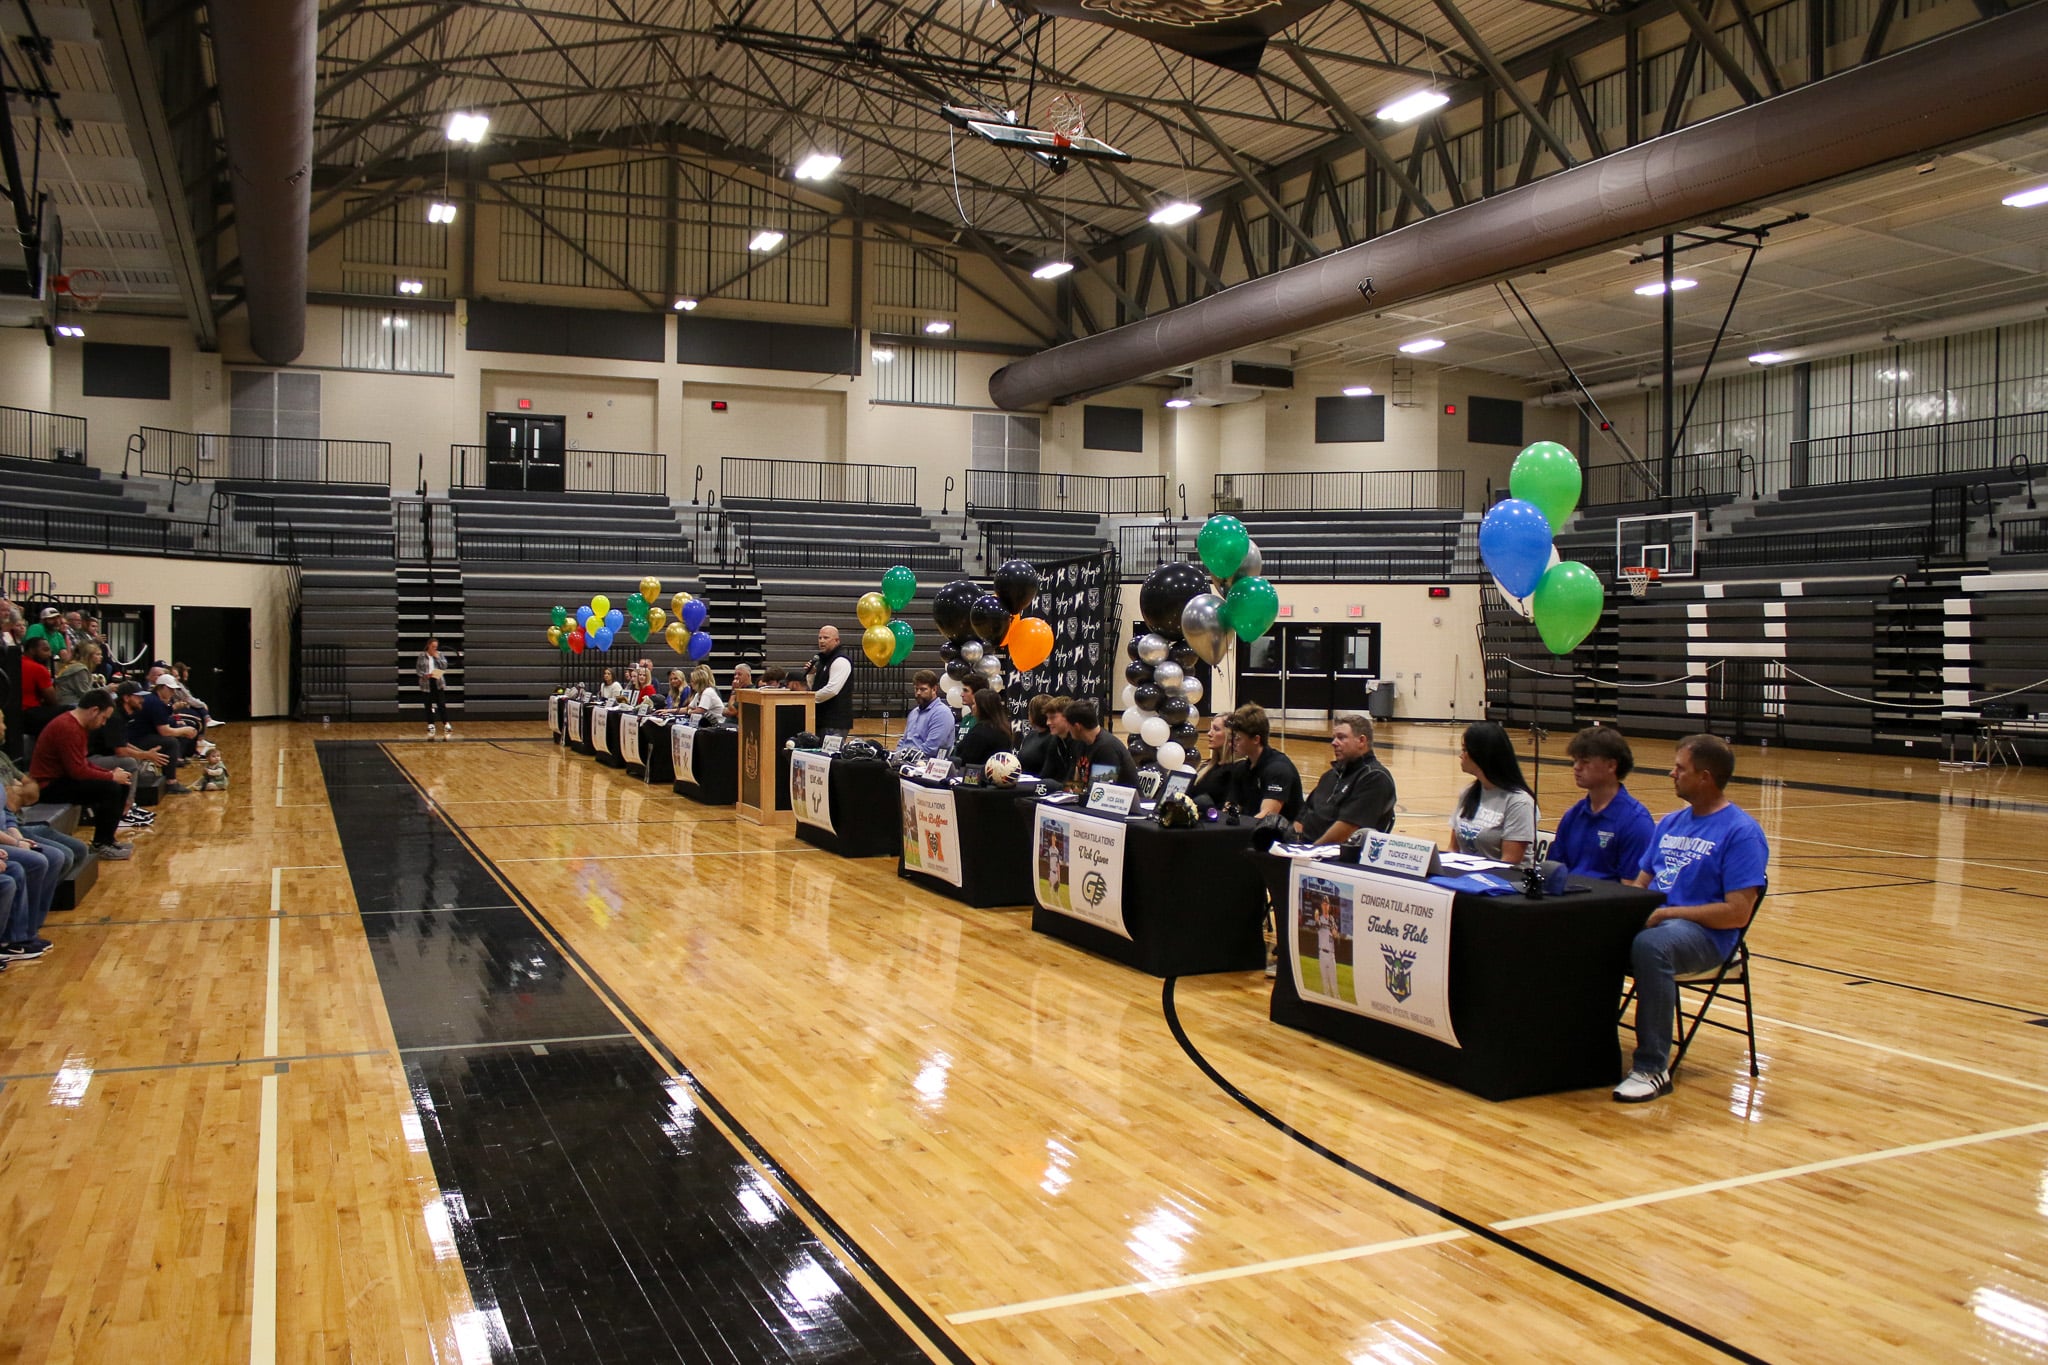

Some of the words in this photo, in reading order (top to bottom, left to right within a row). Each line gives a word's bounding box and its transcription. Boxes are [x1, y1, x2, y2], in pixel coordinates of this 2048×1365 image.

[1073, 829, 1116, 847] CONGRATULATIONS
[1388, 839, 1431, 853] CONGRATULATIONS
[1388, 849, 1409, 860] TUCKER
[1409, 854, 1425, 863] HALE
[1360, 893, 1435, 919] CONGRATULATIONS
[1367, 914, 1399, 937] Tucker
[1402, 923, 1430, 944] Hale
